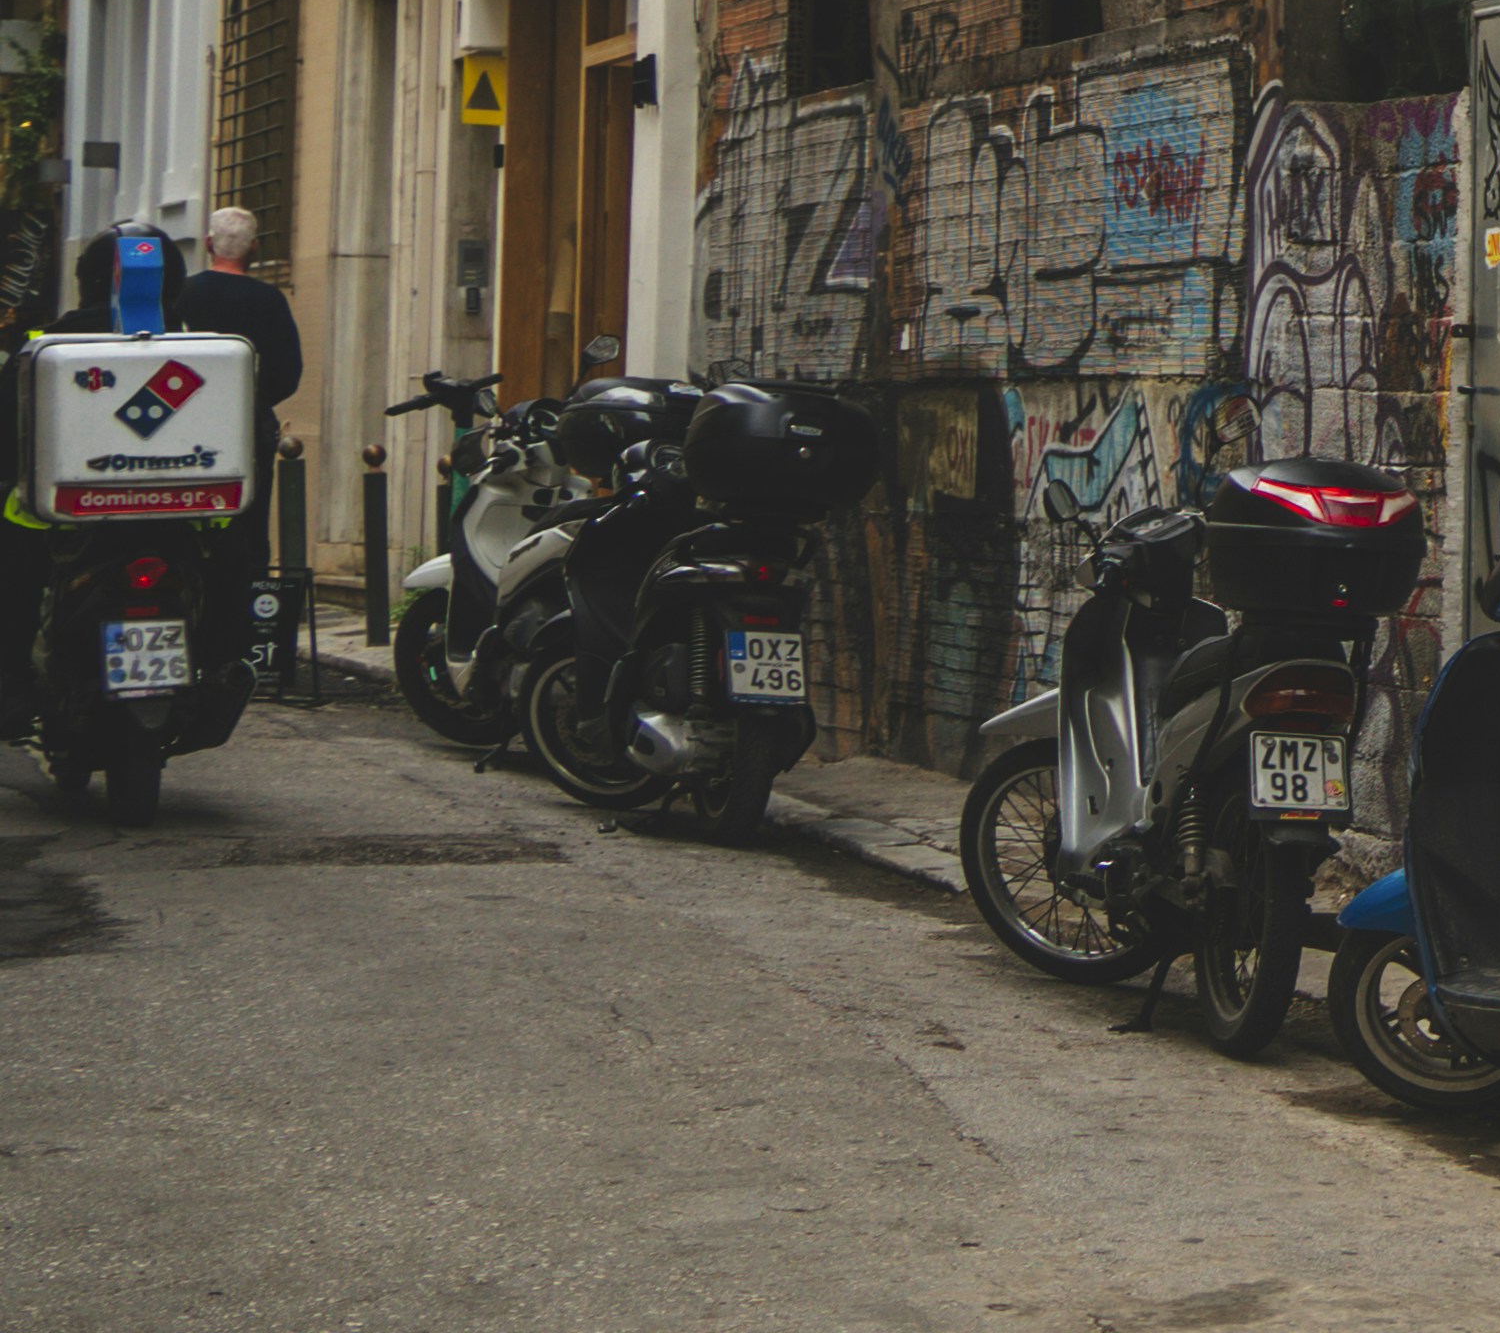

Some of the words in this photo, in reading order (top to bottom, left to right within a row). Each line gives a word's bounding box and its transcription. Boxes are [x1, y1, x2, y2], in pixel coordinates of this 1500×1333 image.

[79, 488, 206, 509] dominos.gr
[748, 638, 801, 663] OXZ
[129, 655, 187, 683] 426
[751, 668, 802, 692] 496
[1270, 772, 1309, 803] 98
